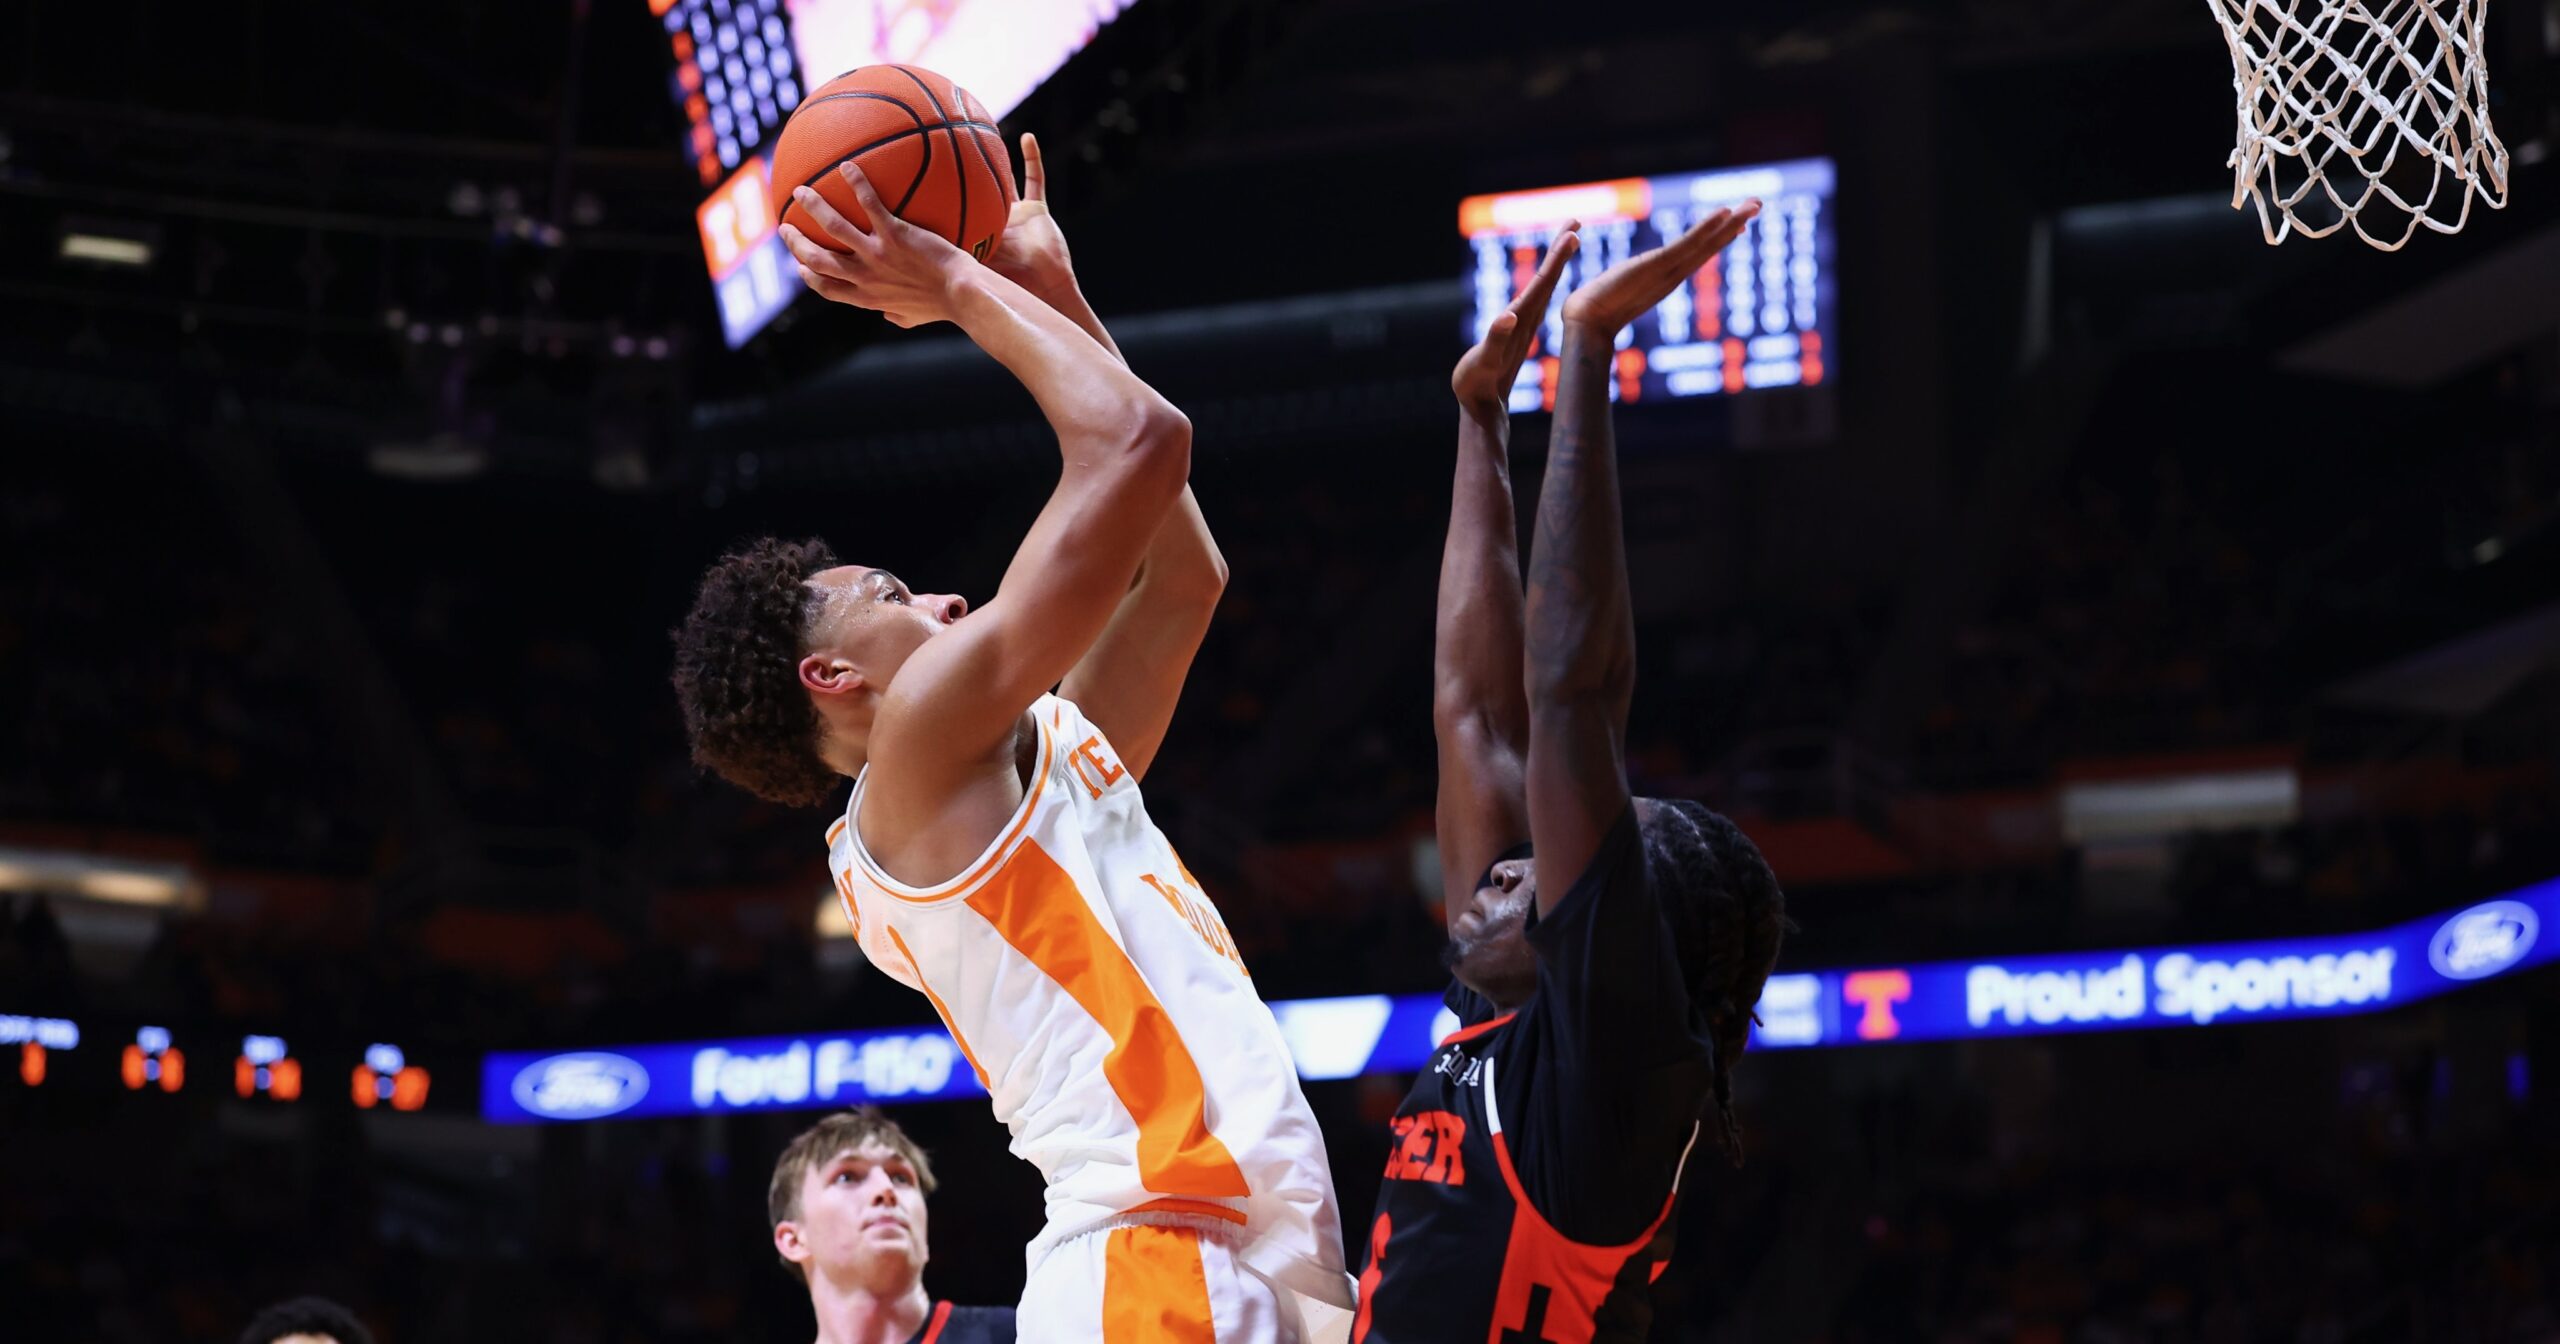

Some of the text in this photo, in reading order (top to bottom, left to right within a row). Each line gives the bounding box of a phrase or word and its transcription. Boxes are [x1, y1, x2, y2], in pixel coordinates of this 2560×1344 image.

[1844, 969, 1912, 1040] T
[1967, 954, 2145, 1026] Proud
[2154, 946, 2394, 1023] Sponsor
[693, 1042, 810, 1106] Ford
